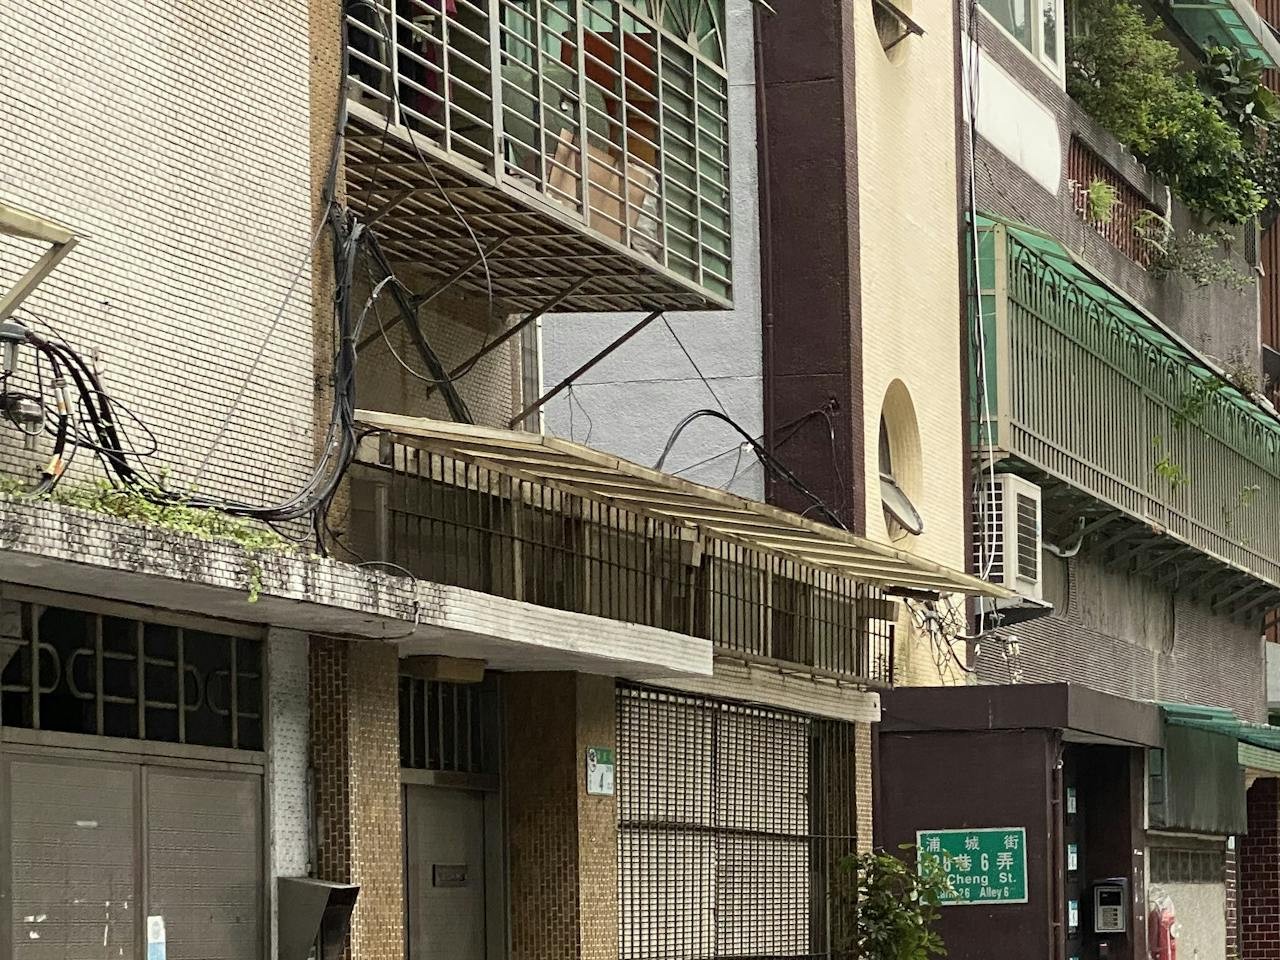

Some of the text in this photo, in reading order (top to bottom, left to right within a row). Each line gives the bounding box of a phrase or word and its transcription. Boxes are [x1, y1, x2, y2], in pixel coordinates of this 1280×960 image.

[926, 834, 1019, 852] 浦城街
[999, 872, 1016, 883] St.
[979, 887, 1002, 899] Alley
[1004, 886, 1010, 897] 6
